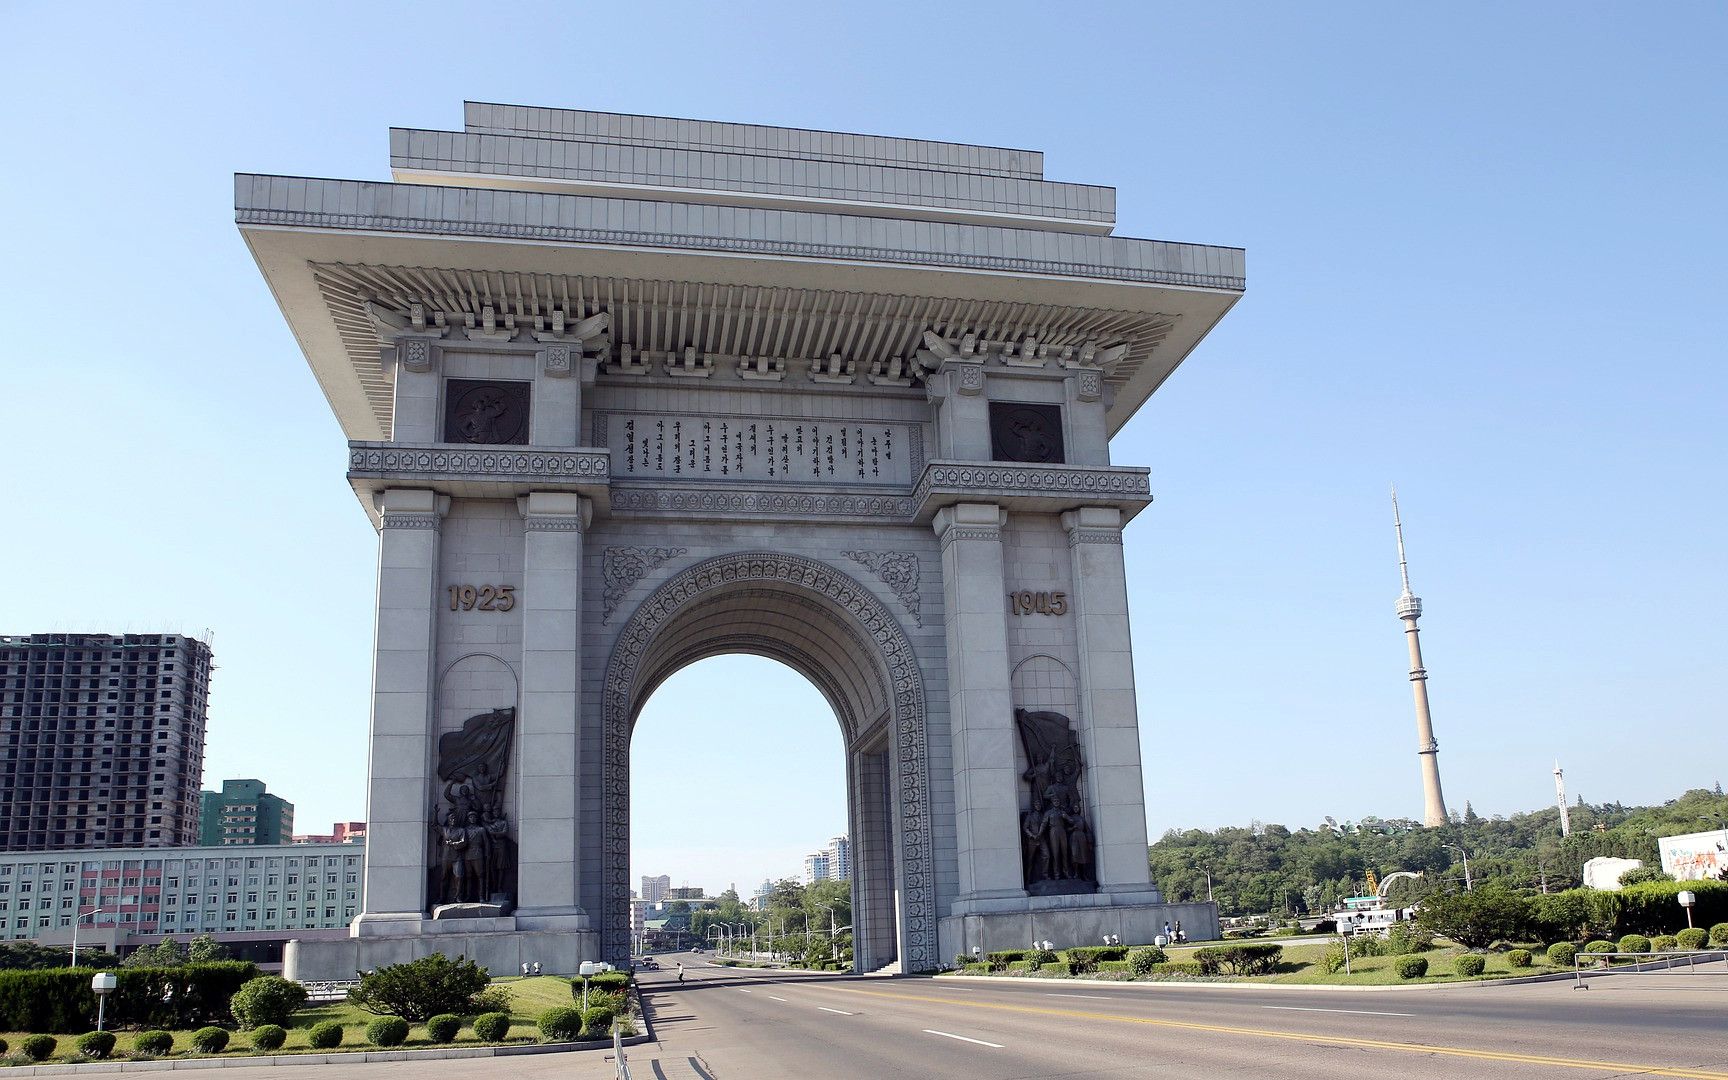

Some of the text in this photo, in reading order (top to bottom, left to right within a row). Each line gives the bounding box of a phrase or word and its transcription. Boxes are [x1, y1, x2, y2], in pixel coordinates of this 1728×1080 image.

[720, 422, 728, 475] 누구인가를
[766, 424, 775, 476] 누구인가를
[812, 426, 820, 477] 이야기하라
[857, 428, 865, 478] 이야기하라
[448, 584, 514, 612] 1925
[1010, 591, 1067, 616] 1945
